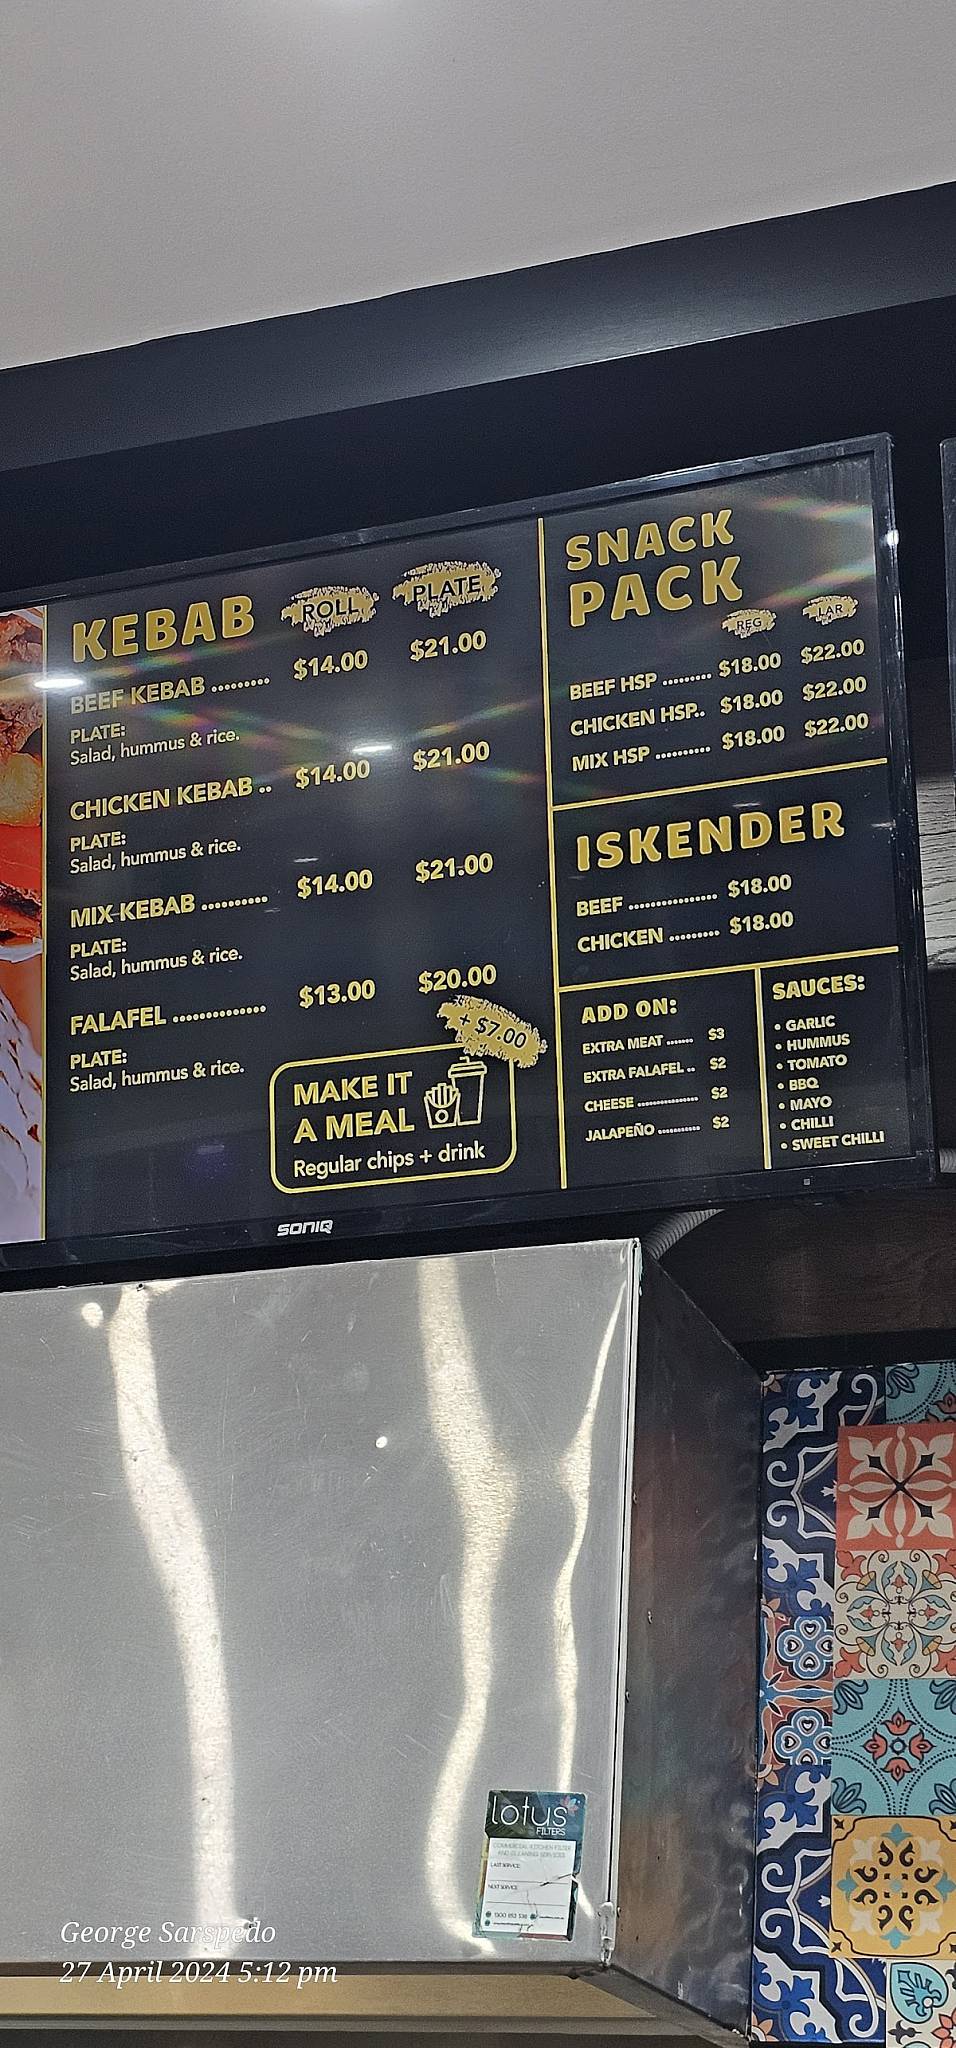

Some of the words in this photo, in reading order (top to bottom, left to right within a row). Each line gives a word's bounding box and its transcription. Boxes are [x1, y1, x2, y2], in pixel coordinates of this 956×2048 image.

[566, 509, 734, 571] SNACK
[413, 575, 481, 601] PLATE
[569, 556, 742, 628] PACK
[302, 602, 359, 621] ROLL
[736, 617, 762, 630] REG
[818, 603, 843, 617] LAR
[72, 595, 255, 662] KEBAB
[70, 690, 123, 714] BEEF
[131, 677, 205, 704] KEBAB
[293, 651, 368, 680] $14.00
[410, 631, 486, 661] $21.00
[570, 679, 615, 701] BEEF
[621, 673, 657, 692] HSP
[718, 652, 781, 678] $18.00
[801, 639, 864, 664] $22.00
[570, 709, 655, 736] CHICKEN
[720, 690, 783, 714] $18.00
[802, 677, 867, 702] $22.00
[70, 724, 126, 744] PLATE:
[70, 748, 115, 765] Salad,
[120, 738, 185, 758] hummus
[190, 733, 202, 747] &
[207, 729, 240, 745] rice.
[572, 752, 608, 771] MIX
[613, 747, 650, 765] HSP
[722, 726, 785, 750] $18.00
[804, 713, 869, 738] $22.00
[70, 789, 170, 820] CHICKEN
[178, 777, 252, 805] KEBAB
[295, 760, 370, 790] $14.00
[413, 742, 490, 771] $21.00
[70, 832, 126, 852] PLATE:
[576, 801, 845, 872] ISKENDER
[70, 856, 115, 874] Salad,
[120, 846, 186, 866] hummus
[191, 842, 203, 857] &
[208, 838, 240, 856] rice.
[70, 908, 113, 928] MIX
[119, 895, 195, 921] KEBAB
[297, 870, 373, 899] $14.00
[415, 853, 493, 883] $21.00
[576, 897, 623, 917] BEEF
[728, 874, 792, 898] $18.00
[577, 928, 663, 953] CHICKEN
[730, 911, 794, 936] $18.00
[70, 938, 127, 958] PLATE:
[70, 964, 116, 981] Salad,
[121, 955, 187, 975] hummus
[192, 950, 205, 965] &
[209, 947, 242, 963] rice.
[70, 1006, 166, 1035] FALAFEL
[299, 980, 375, 1008] $13.00
[418, 965, 497, 994] $20.00
[772, 974, 865, 1000] SAUCES:
[582, 1003, 628, 1023] ADD
[636, 998, 677, 1018] ON:
[786, 1015, 835, 1032] GARLIC
[475, 1016, 527, 1049] $7.00
[582, 1039, 625, 1055] EXTRA
[627, 1035, 663, 1050] MEAT
[708, 1028, 724, 1041] $3
[787, 1034, 850, 1051] HUMMUS
[70, 1049, 127, 1070] PLATE:
[583, 1069, 625, 1084] EXTRA
[629, 1062, 684, 1079] FALAFEL
[710, 1057, 726, 1070] $2
[788, 1055, 847, 1071] TOMATO
[70, 1075, 117, 1093] Salad,
[121, 1066, 189, 1086] hummus
[193, 1062, 206, 1077] &
[210, 1059, 244, 1075] rice.
[293, 1075, 378, 1106] MAKE
[388, 1072, 412, 1095] IT
[789, 1078, 819, 1091] BBQ
[584, 1097, 634, 1113] CHEESE
[711, 1087, 728, 1099] $2
[790, 1097, 832, 1110] MAYO
[293, 1119, 317, 1143] A
[326, 1109, 414, 1140] MEAL
[585, 1123, 655, 1142] JALAPEÑO
[713, 1116, 729, 1129] $2
[791, 1116, 833, 1131] CHILLI
[792, 1136, 839, 1151] SWEET
[842, 1131, 885, 1147] CHILLI
[294, 1155, 361, 1179] Regular
[367, 1150, 414, 1174] chips
[419, 1150, 432, 1163] +
[438, 1141, 485, 1162] drink
[492, 1796, 567, 1827] lotus
[536, 1827, 565, 1836] FILTERS
